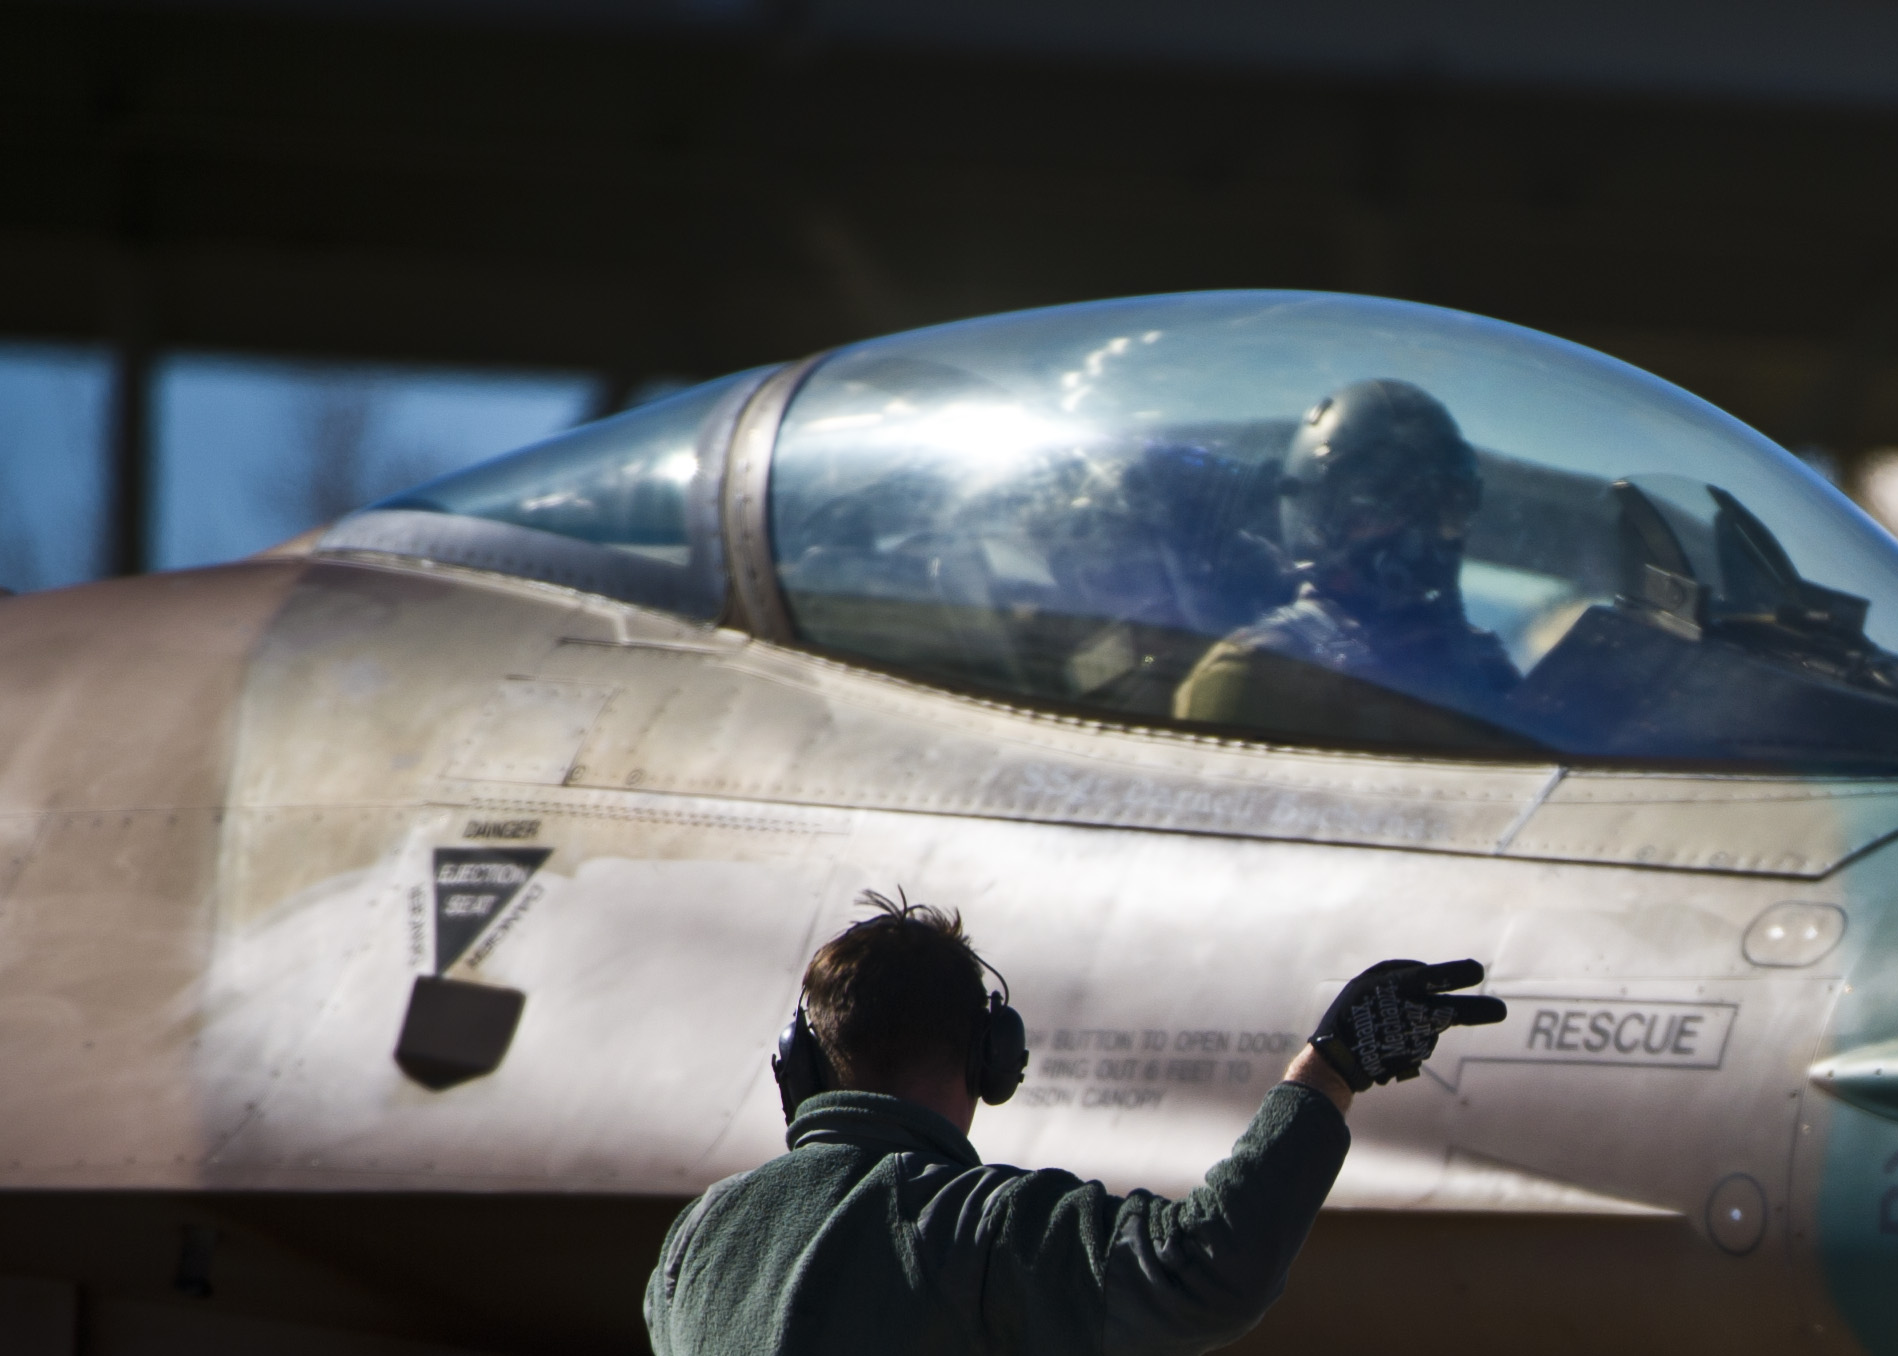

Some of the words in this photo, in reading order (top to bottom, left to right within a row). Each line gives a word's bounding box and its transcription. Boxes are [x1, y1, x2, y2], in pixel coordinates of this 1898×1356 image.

[462, 820, 542, 838] DANGER
[437, 863, 530, 884] EJECTION
[445, 894, 498, 915] SEAT
[1052, 1029, 1133, 1051] BUTTON
[1141, 1029, 1168, 1051] TO
[1174, 1030, 1230, 1052] OPEN
[1527, 1009, 1705, 1055] RESCUE
[1095, 1059, 1138, 1080] OUT
[1166, 1060, 1216, 1081] FEET
[1227, 1061, 1252, 1083] TO
[1081, 1088, 1168, 1109] CANOPY
